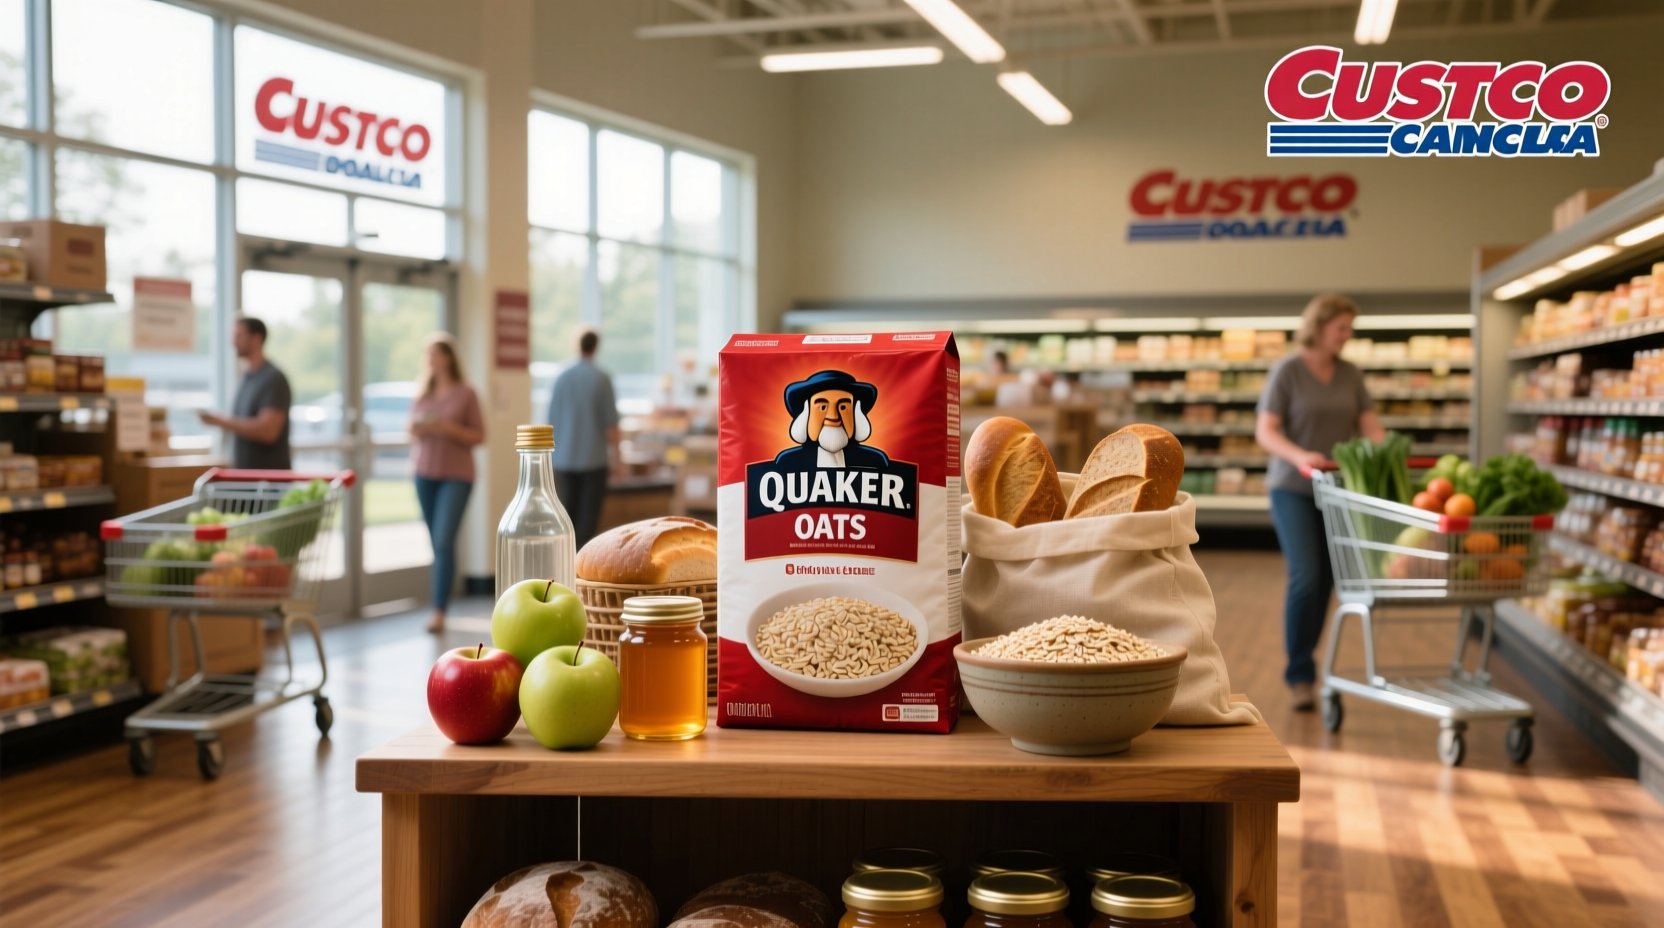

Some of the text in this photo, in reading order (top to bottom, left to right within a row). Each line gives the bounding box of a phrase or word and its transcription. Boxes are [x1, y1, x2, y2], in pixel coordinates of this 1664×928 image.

[255, 77, 431, 162] CUSTCO
[1130, 169, 1357, 217] CUSTCO
[759, 471, 906, 512] QUAKER
[794, 513, 867, 540] OATS
